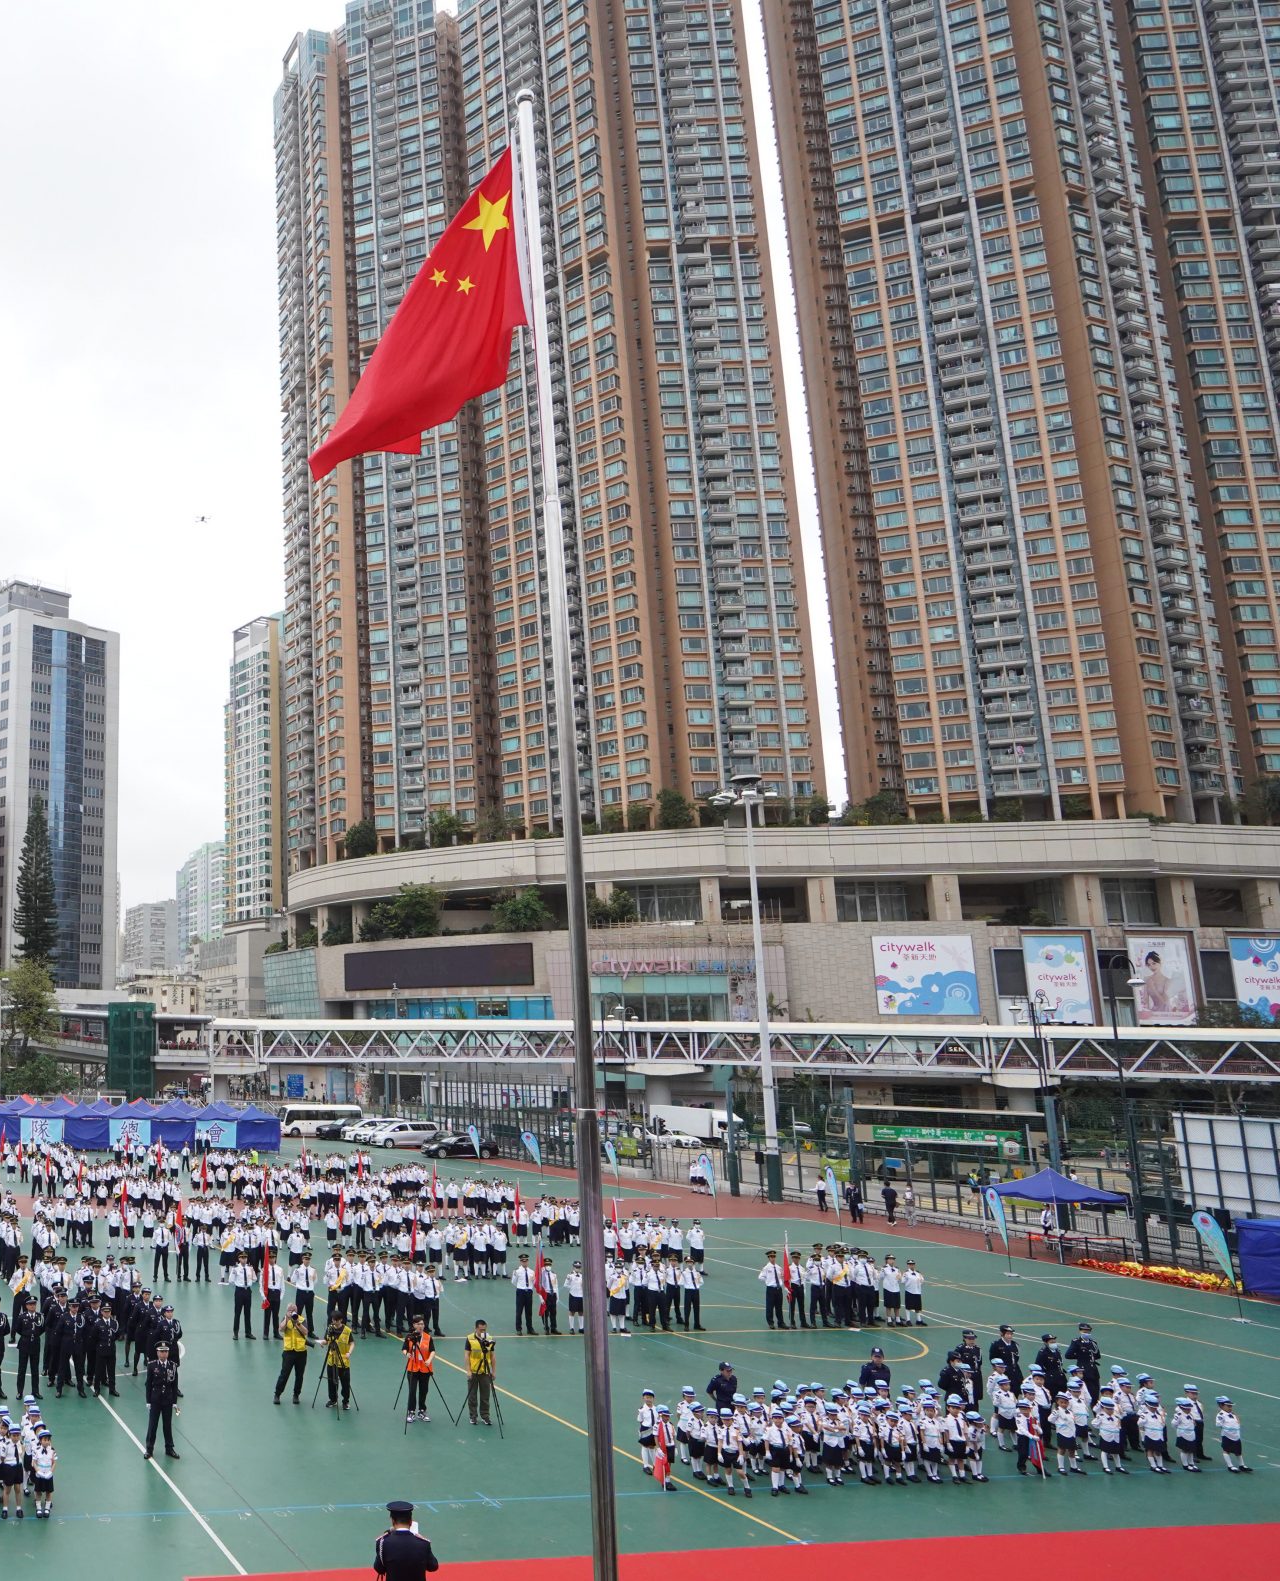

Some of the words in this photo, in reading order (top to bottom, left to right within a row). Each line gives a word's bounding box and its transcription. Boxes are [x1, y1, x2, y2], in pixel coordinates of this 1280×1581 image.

[880, 942, 936, 955] citywalk
[1038, 973, 1077, 982] citywalk
[32, 1119, 51, 1140] 隊
[120, 1120, 141, 1142] 總
[208, 1122, 225, 1144] 會
